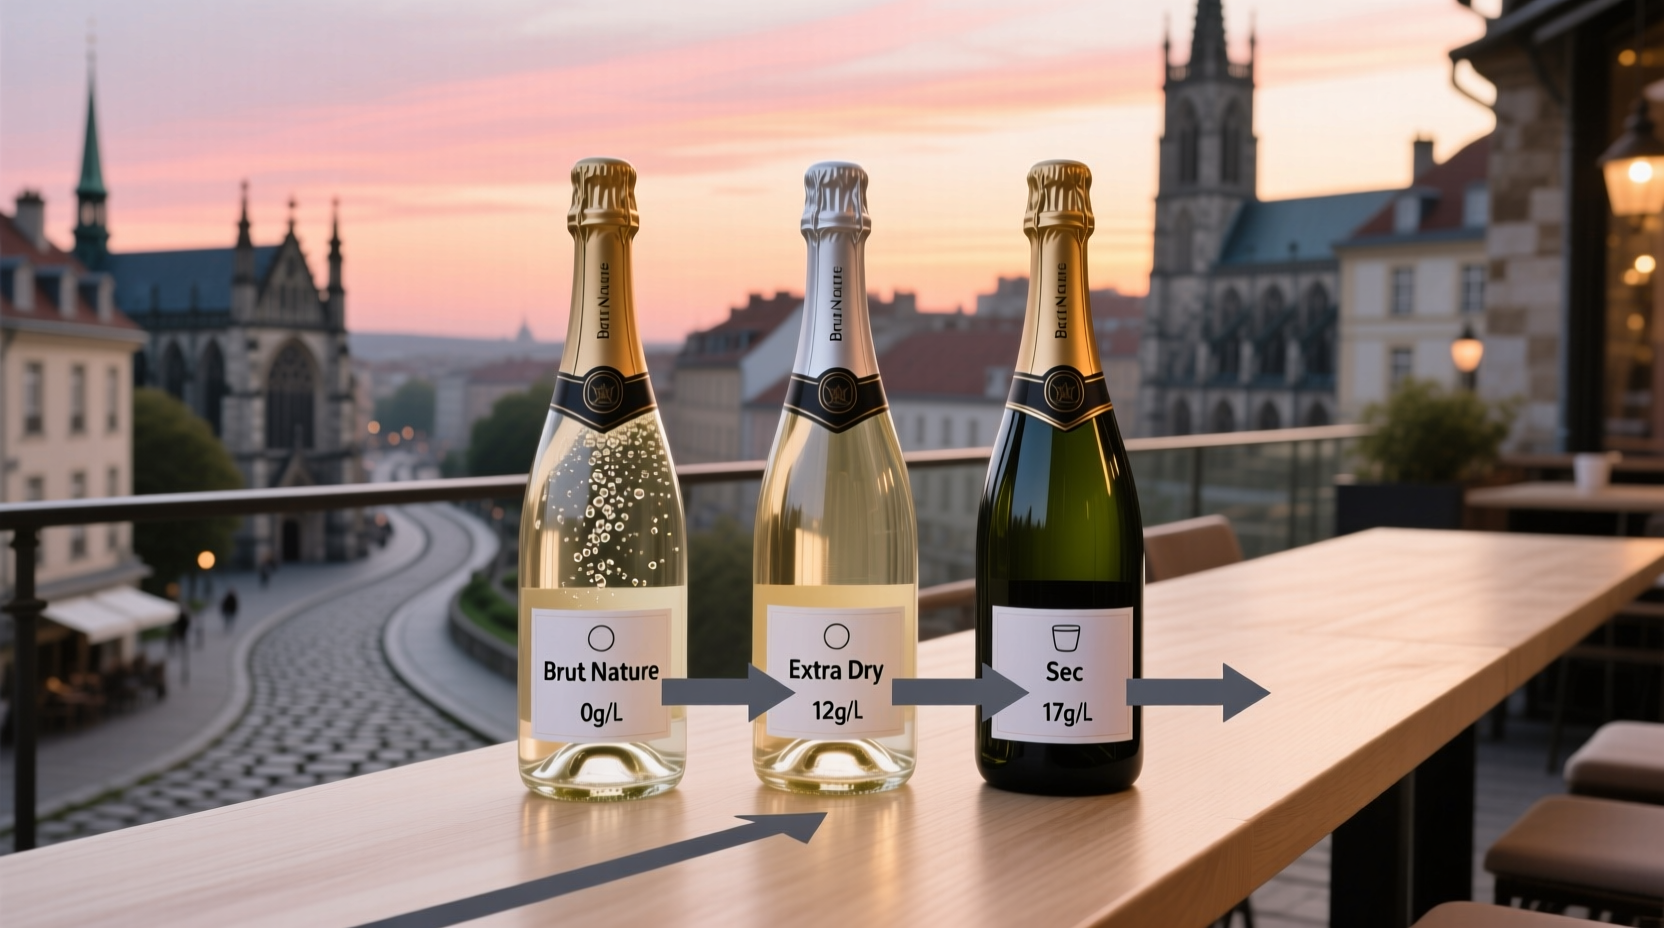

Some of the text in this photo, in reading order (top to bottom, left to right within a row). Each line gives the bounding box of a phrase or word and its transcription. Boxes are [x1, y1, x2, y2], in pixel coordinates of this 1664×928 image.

[543, 660, 660, 683] Brut Nature
[789, 658, 885, 685] Extra Dry
[1046, 660, 1084, 683] Sec
[580, 701, 624, 727] 0g/L
[812, 699, 864, 724] 12g/L
[1042, 701, 1093, 727] 17g/L
